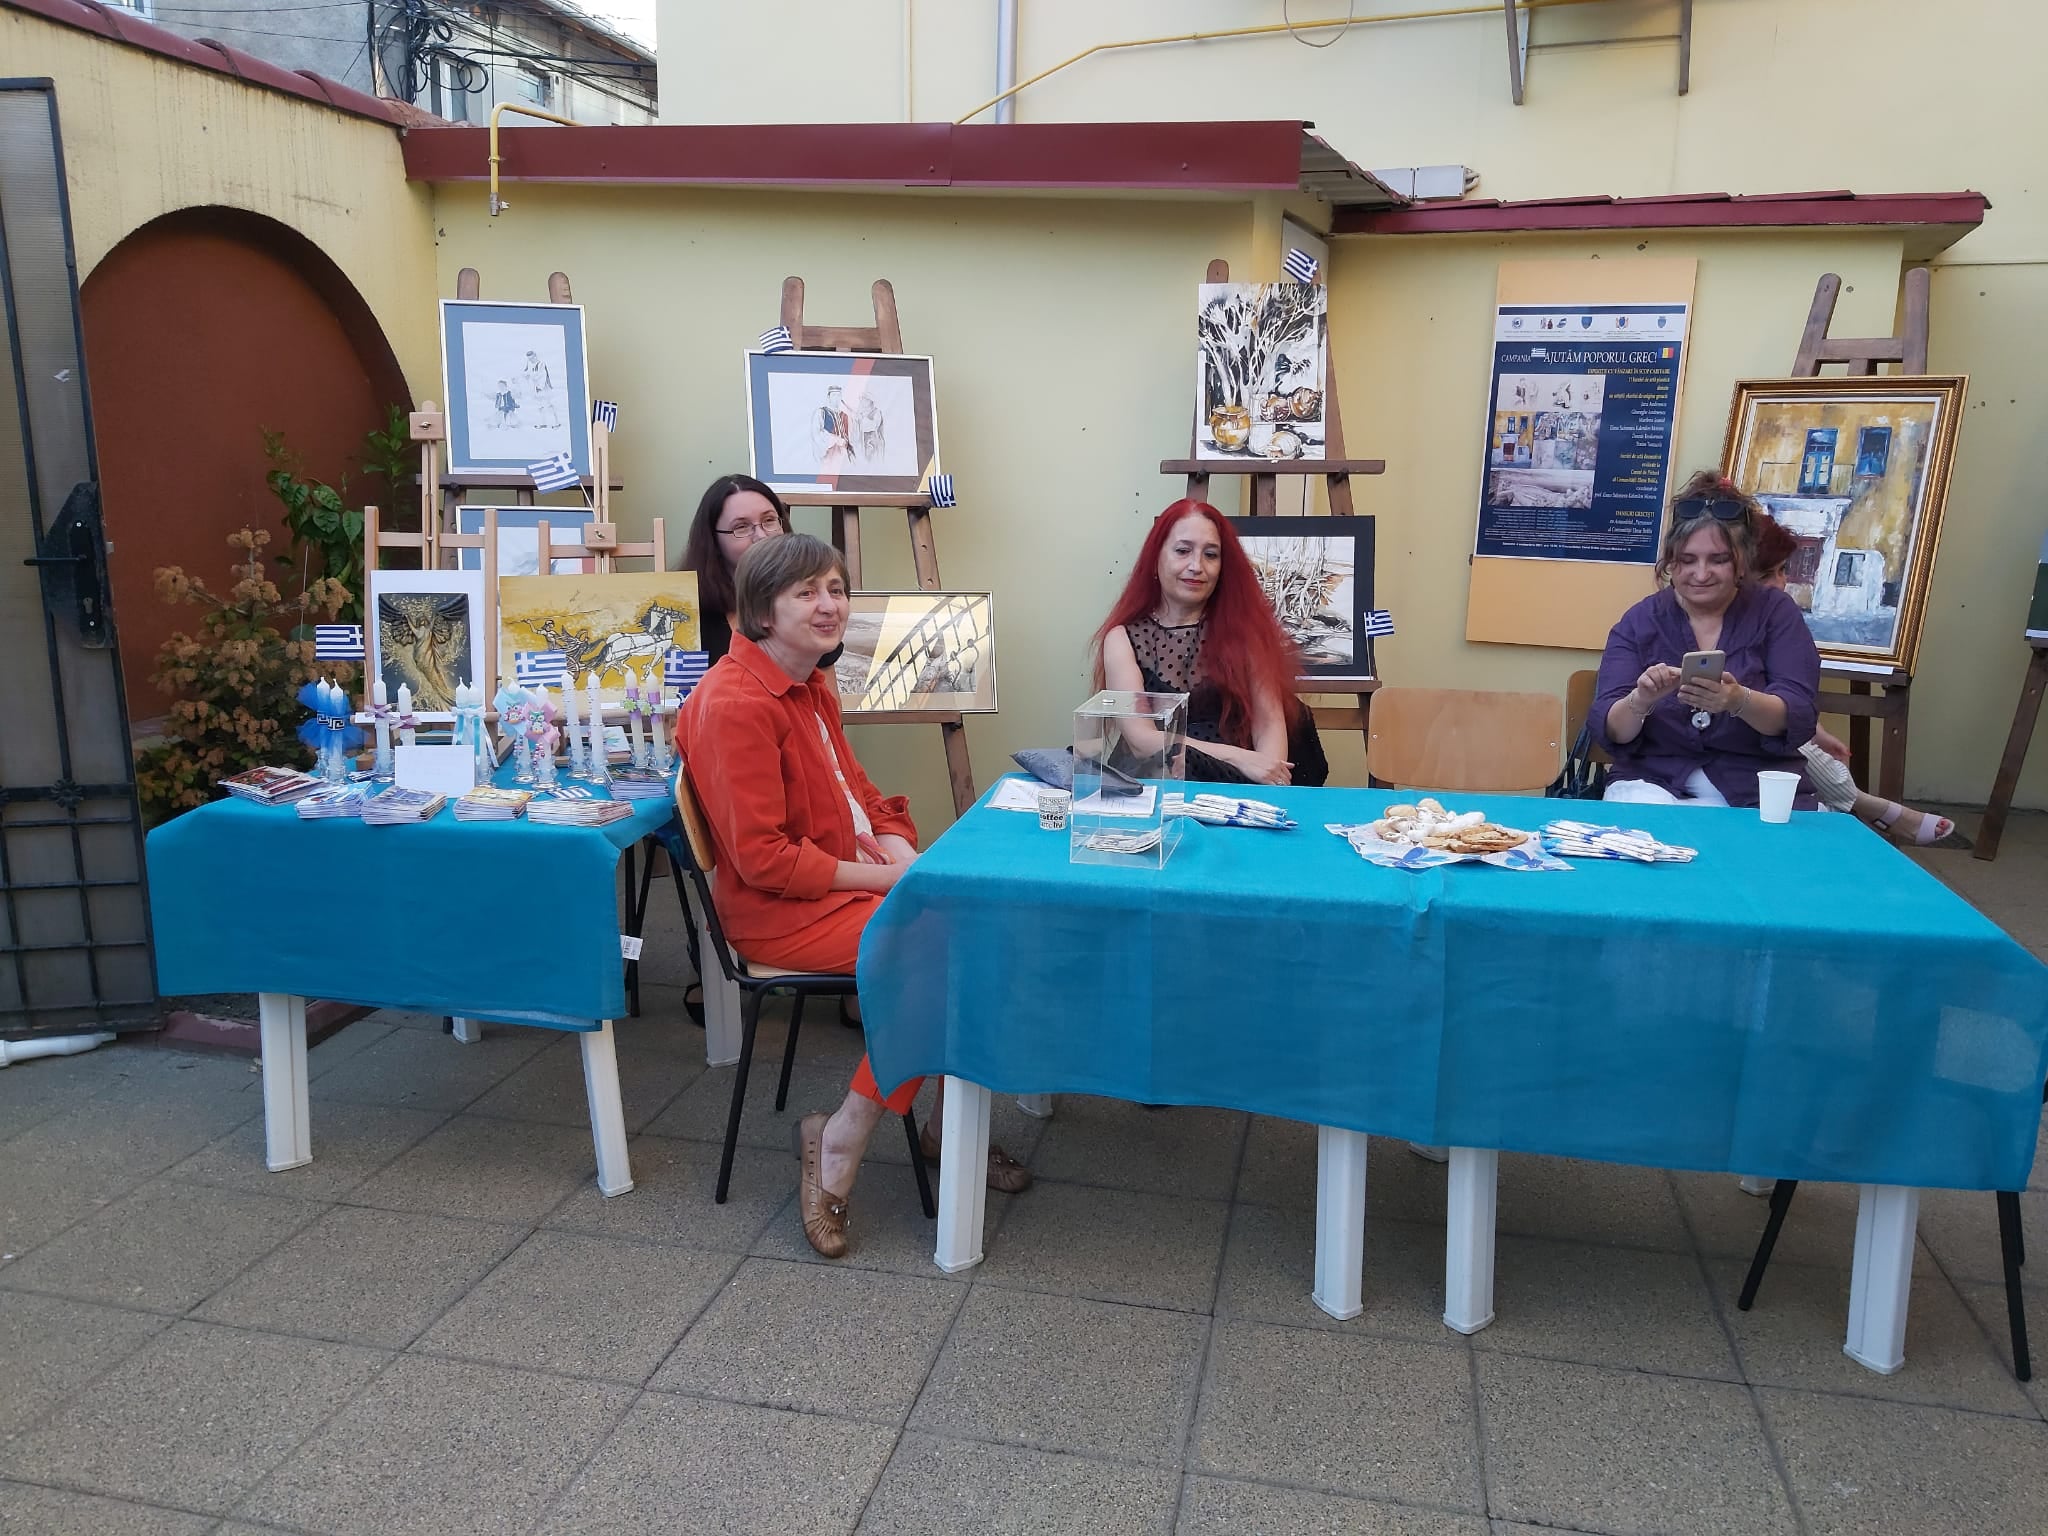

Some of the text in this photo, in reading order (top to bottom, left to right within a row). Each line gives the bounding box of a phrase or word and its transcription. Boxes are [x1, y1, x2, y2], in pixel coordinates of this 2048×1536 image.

[1501, 349, 1657, 366] CAMPANIA AJUTĂM POPORUL GREC!
